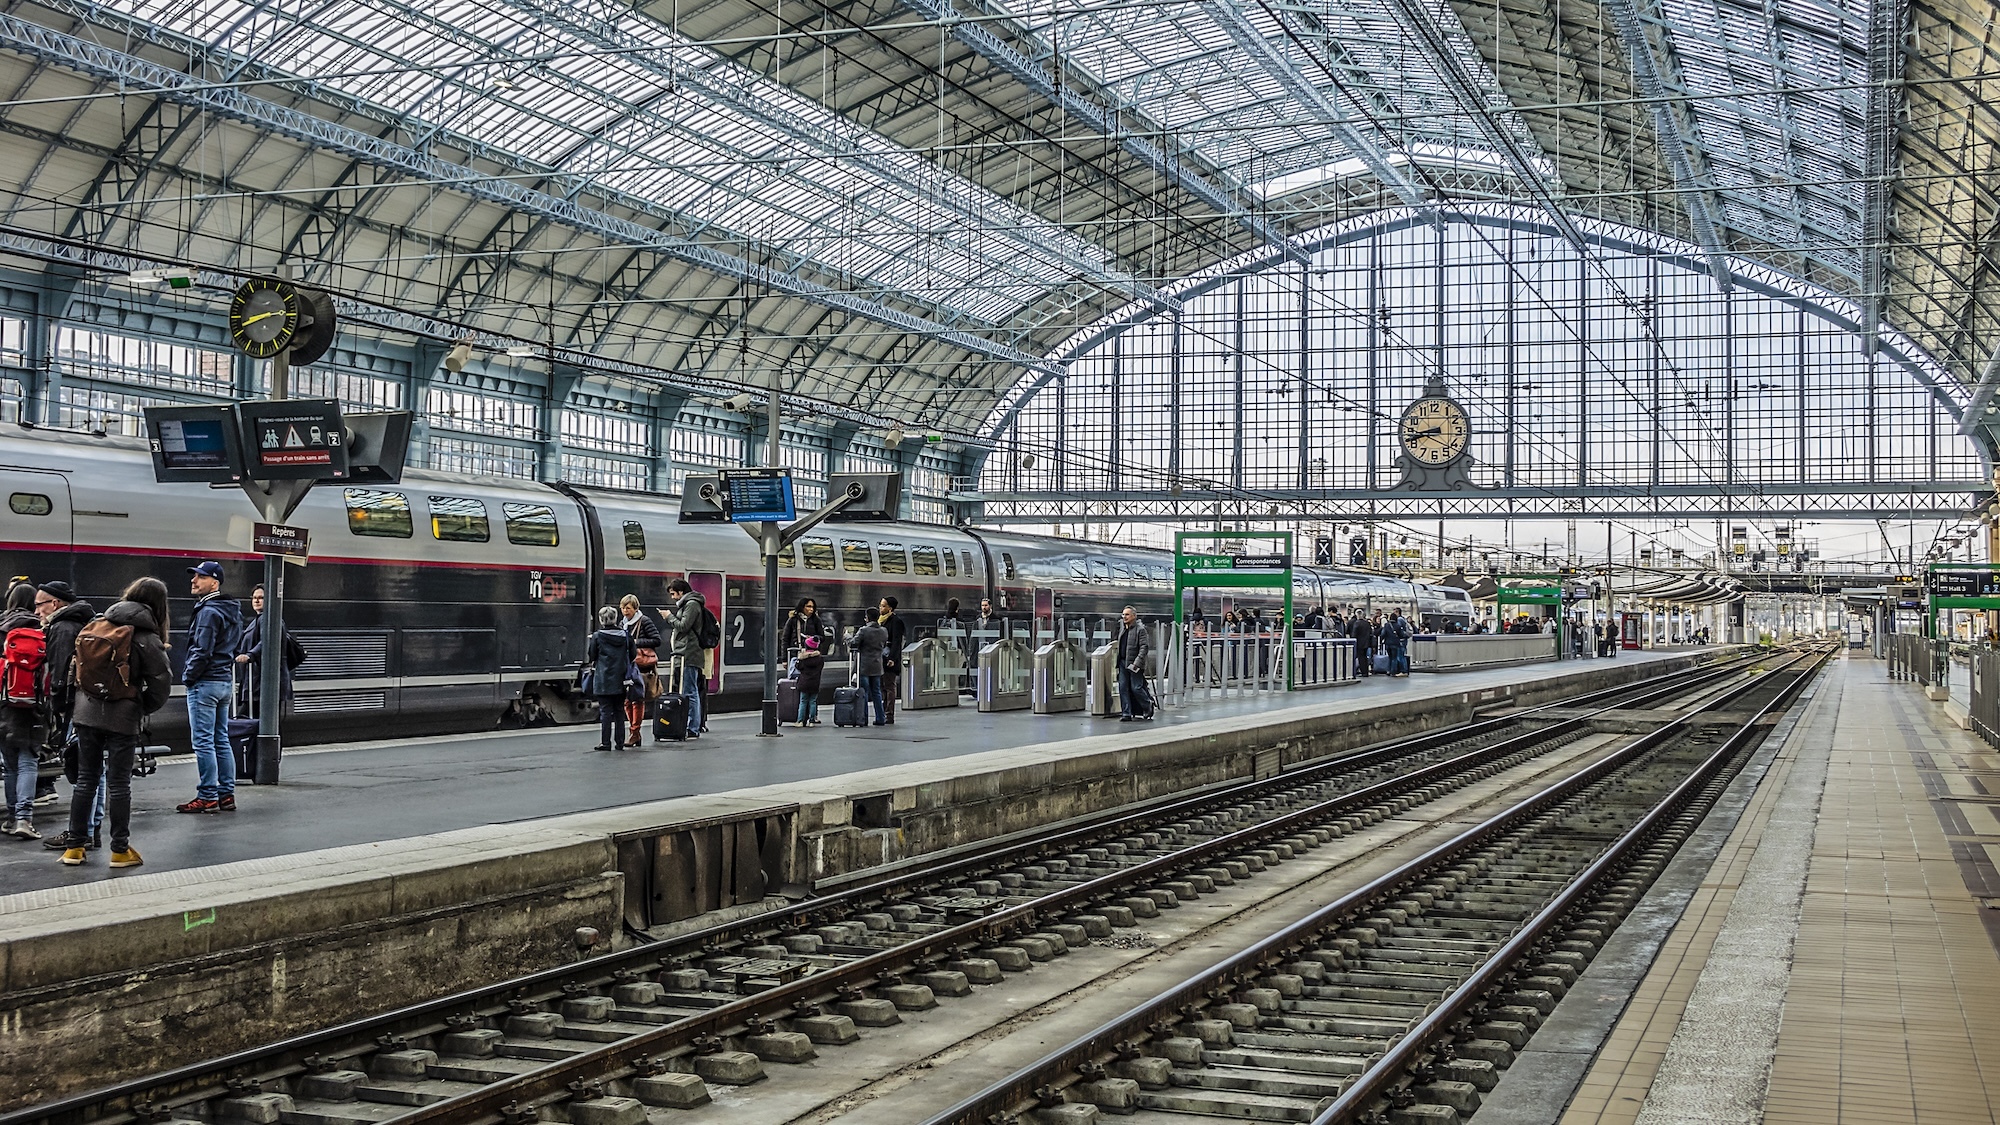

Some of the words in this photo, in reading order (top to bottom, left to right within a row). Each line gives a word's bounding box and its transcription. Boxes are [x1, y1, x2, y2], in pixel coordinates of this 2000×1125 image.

[1420, 407, 1427, 416] 11
[1430, 403, 1439, 413] 12
[1410, 416, 1419, 426] 10
[1452, 415, 1459, 424] 2
[1455, 427, 1463, 436] 3
[1410, 439, 1418, 449] 8
[1450, 438, 1458, 448] 4
[1420, 448, 1427, 458] 7
[1431, 450, 1439, 460] 6
[1442, 447, 1450, 457] 5
[272, 525, 296, 537] Repères
[1318, 542, 1329, 556] X
[1353, 542, 1364, 556] X
[1235, 557, 1281, 565] Correspondances
[530, 571, 542, 579] TGV
[733, 615, 745, 648] 2
